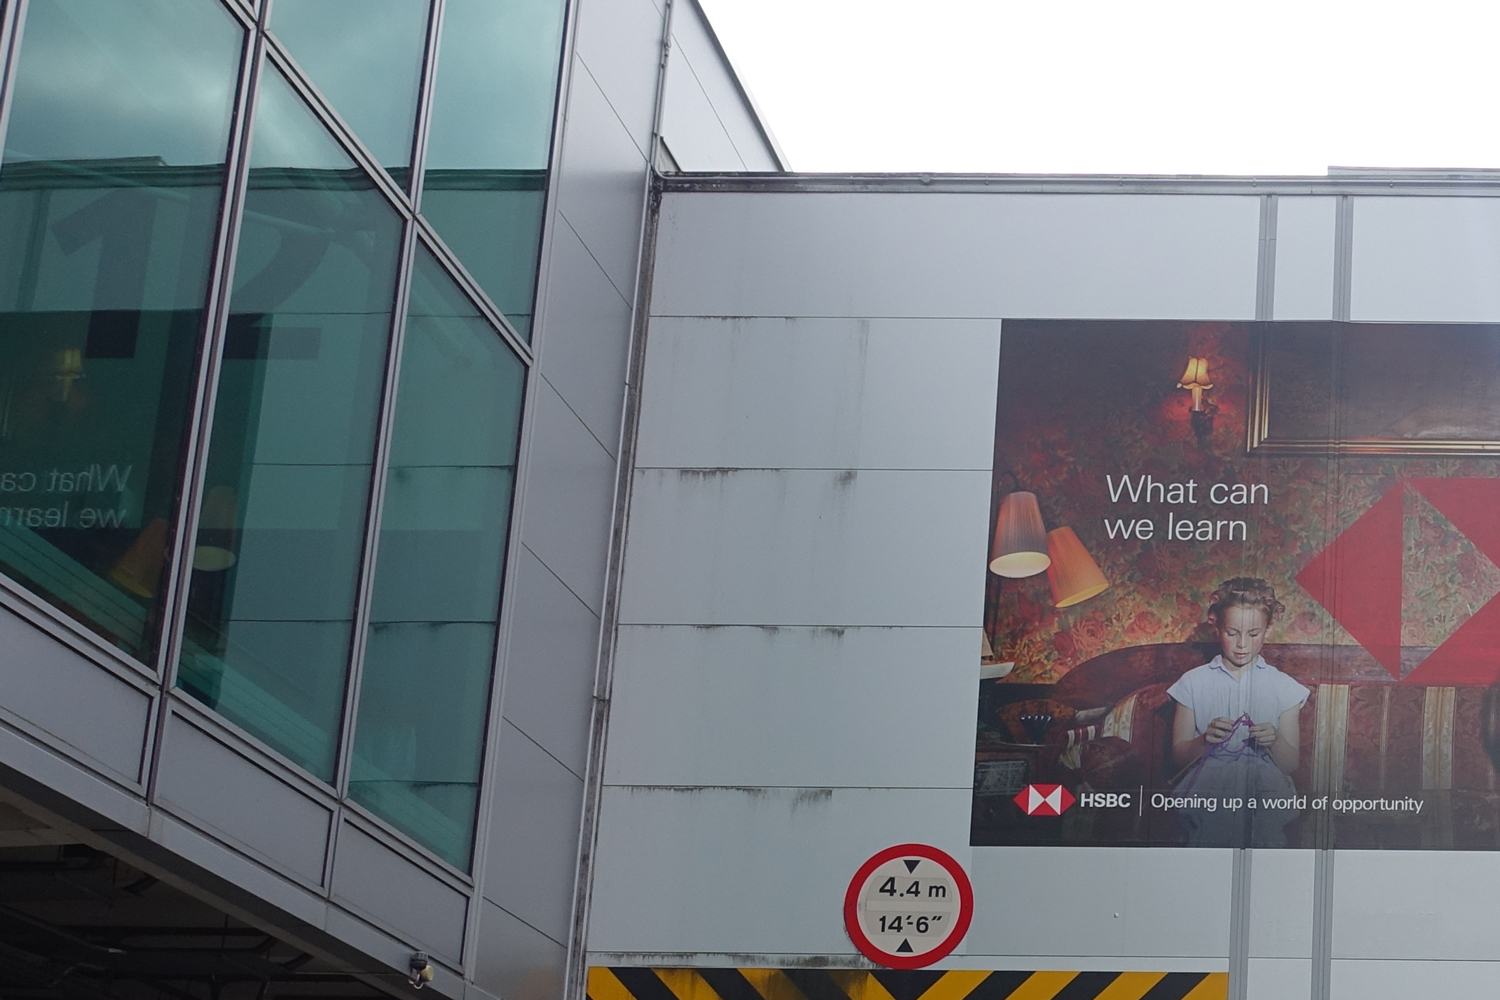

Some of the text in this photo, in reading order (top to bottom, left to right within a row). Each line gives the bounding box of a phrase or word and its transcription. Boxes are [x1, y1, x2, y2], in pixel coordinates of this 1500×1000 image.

[1106, 474, 1269, 505] What can
[1104, 512, 1247, 541] we learn
[1080, 793, 1132, 808] HSBC
[1151, 793, 1424, 814] Opening up a world of opportunity
[879, 876, 947, 898] 4.4 m
